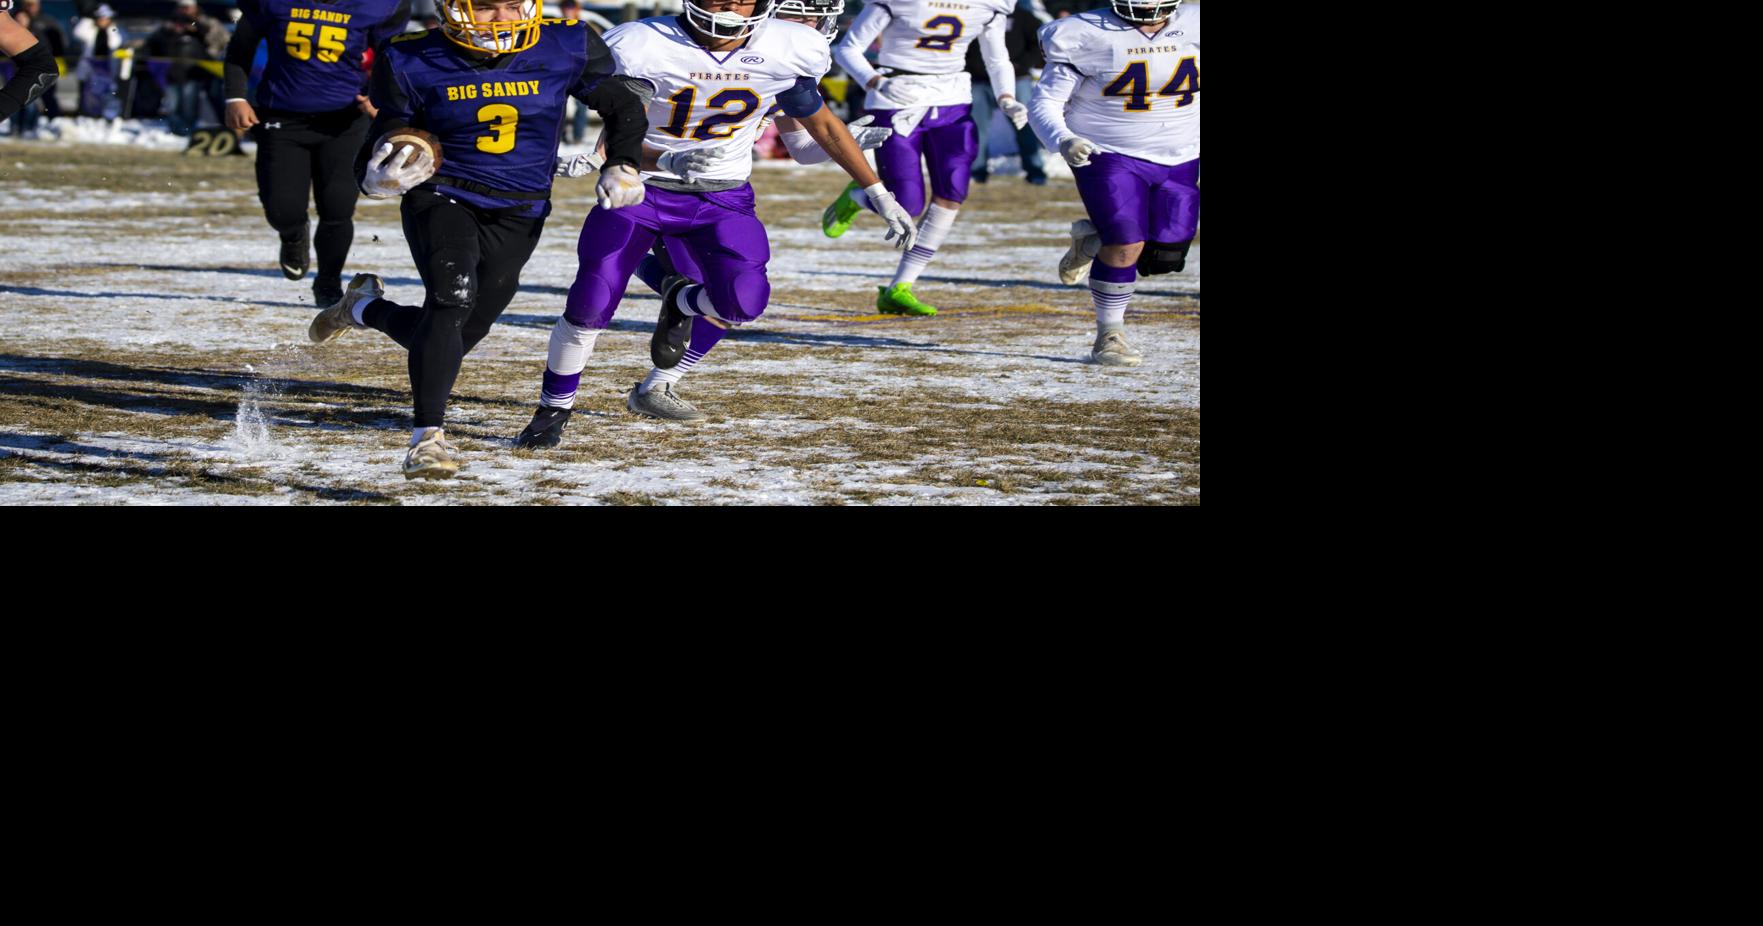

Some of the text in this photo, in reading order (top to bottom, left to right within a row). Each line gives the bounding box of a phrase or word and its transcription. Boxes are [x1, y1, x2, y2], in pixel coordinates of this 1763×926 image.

[290, 8, 352, 24] BIG SANDY
[285, 21, 348, 63] 55
[914, 14, 965, 53] 2
[1127, 45, 1177, 55] PIRATES
[447, 80, 540, 101] BIG SANDY
[689, 72, 750, 81] PIRATES
[1103, 55, 1200, 113] 44
[476, 103, 519, 154] 3
[656, 85, 762, 142] 12
[188, 131, 235, 156] 20
